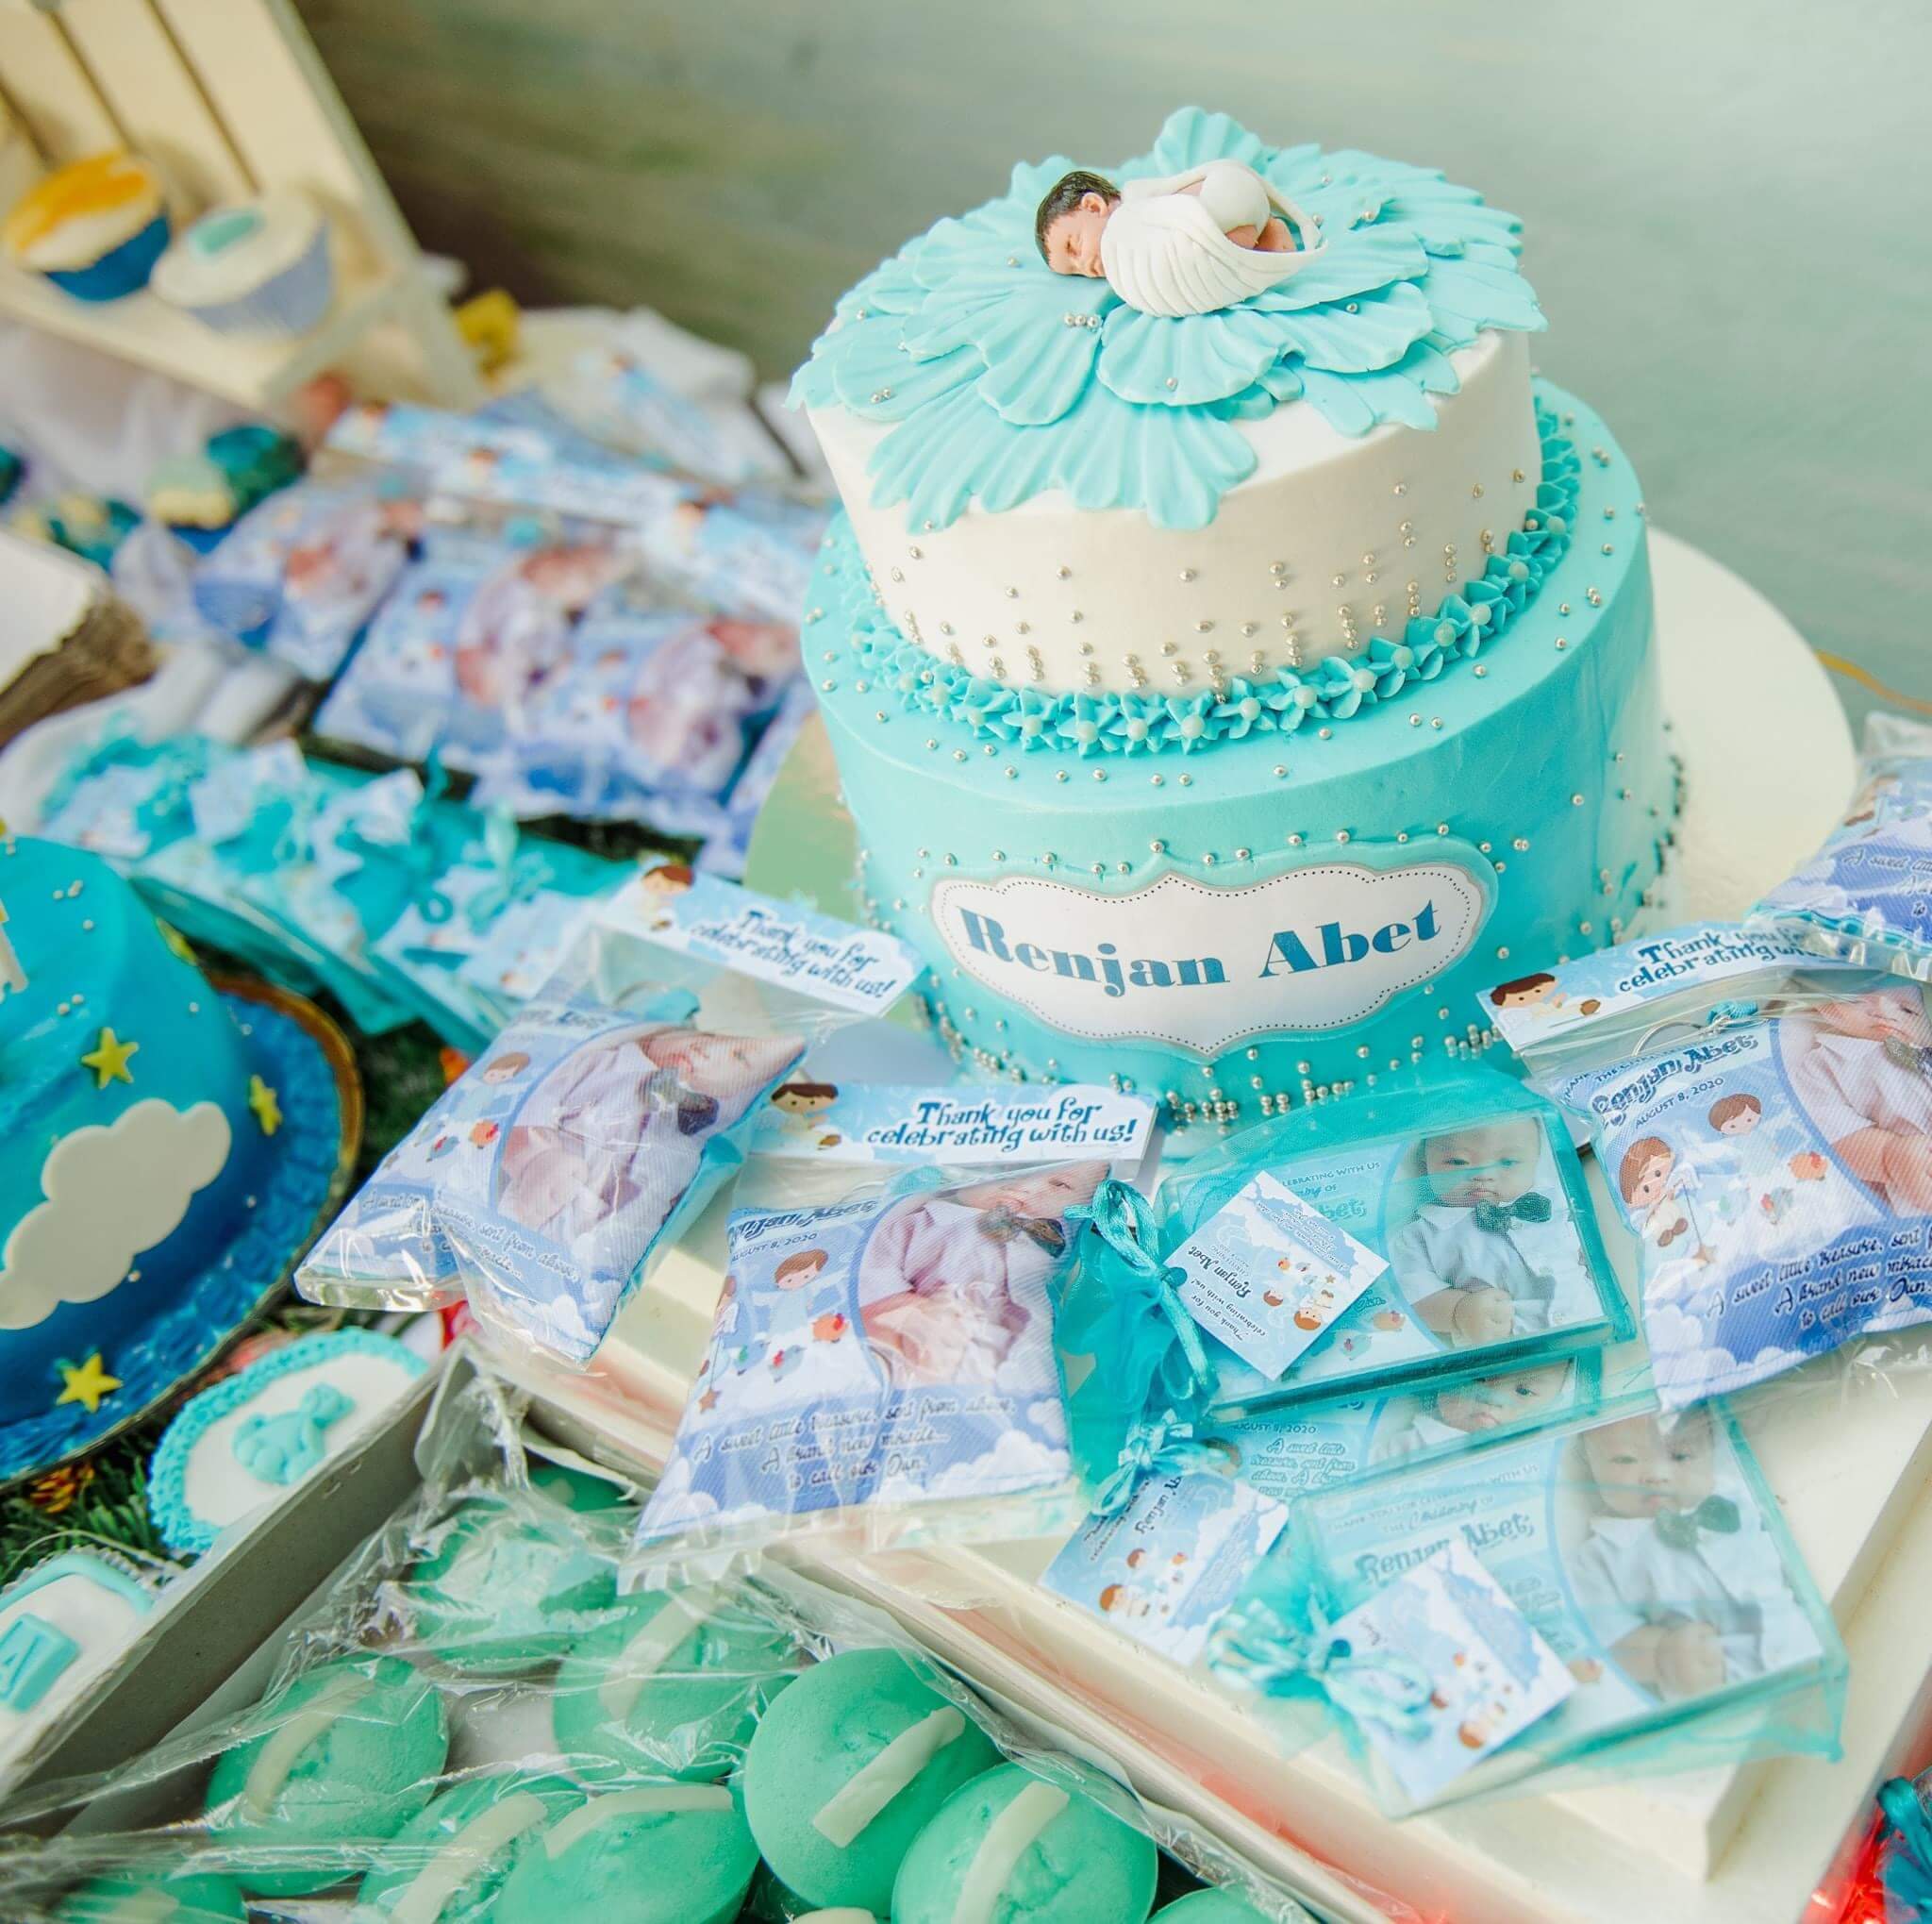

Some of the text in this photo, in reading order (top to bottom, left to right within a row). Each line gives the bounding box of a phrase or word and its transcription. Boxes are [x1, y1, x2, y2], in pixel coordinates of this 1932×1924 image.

[739, 910, 880, 972] Thank you for
[957, 898, 1441, 997] Renjan Abet
[1638, 931, 1731, 965] Thank
[691, 923, 897, 997] celebrating with us!
[1619, 943, 1776, 991] celebrating
[1591, 1058, 1684, 1127] Renjan
[1635, 1077, 1724, 1129] AUGUST 8, 2020
[917, 1096, 1103, 1129] Thank you for
[867, 1118, 1139, 1153] celebrating with us!
[1282, 1162, 1380, 1187] LEBRATING WITH US
[731, 1232, 818, 1263] AUGUST 8, 2020
[1188, 1245, 1219, 1271] Abet
[1214, 1267, 1253, 1298] Renjan
[1707, 1291, 1724, 1317] A
[1734, 1271, 1773, 1304] sweet
[1890, 1230, 1920, 1247] sent
[1774, 1254, 1932, 1314] A brand new mirac
[1207, 1288, 1225, 1305] with
[1800, 1310, 1815, 1329] to
[1822, 1296, 1846, 1321] call
[1851, 1289, 1882, 1304] our
[1191, 1293, 1244, 1342] Thank you for
[1226, 1302, 1267, 1337] celebrating
[693, 1435, 712, 1462] A
[721, 1429, 761, 1451] sweet
[1286, 1425, 1317, 1433] 2020
[761, 1447, 781, 1472] A
